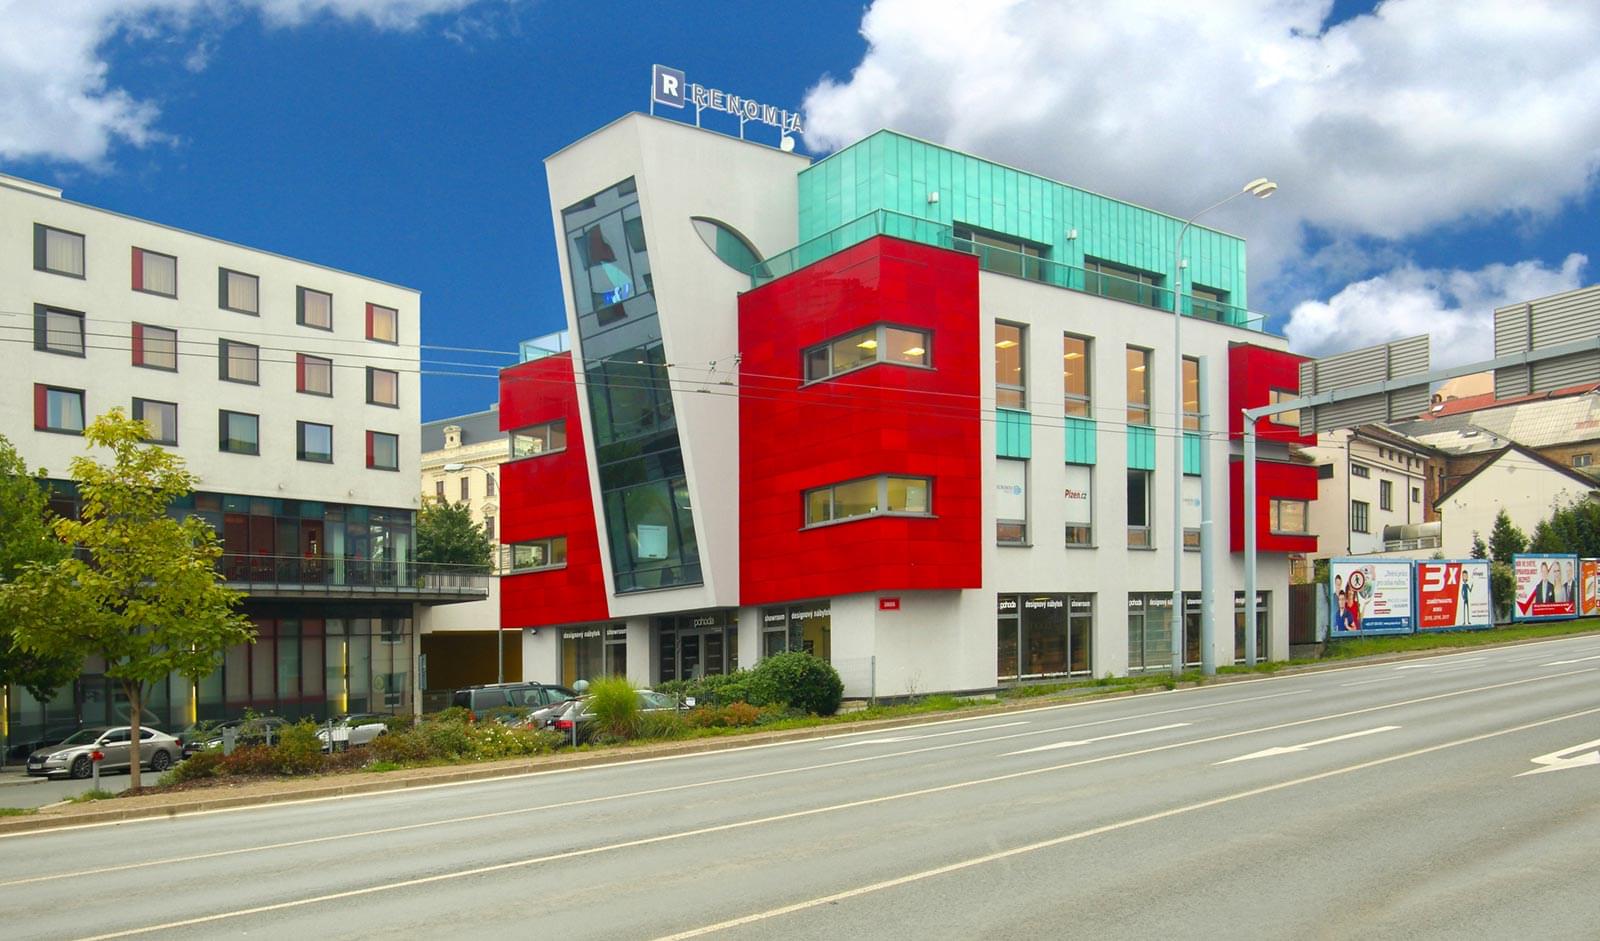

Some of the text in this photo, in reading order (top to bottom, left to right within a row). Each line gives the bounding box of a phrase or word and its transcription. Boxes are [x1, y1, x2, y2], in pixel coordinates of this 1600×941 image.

[661, 73, 804, 134] R RENOMIA
[999, 599, 1091, 610] pohoda designový nábytek showroom
[1128, 599, 1143, 607] pohoda
[694, 615, 714, 628] pohoda
[764, 614, 785, 623] showroom
[791, 610, 813, 620] designový
[563, 631, 584, 640] designový
[584, 629, 601, 639] nábytek
